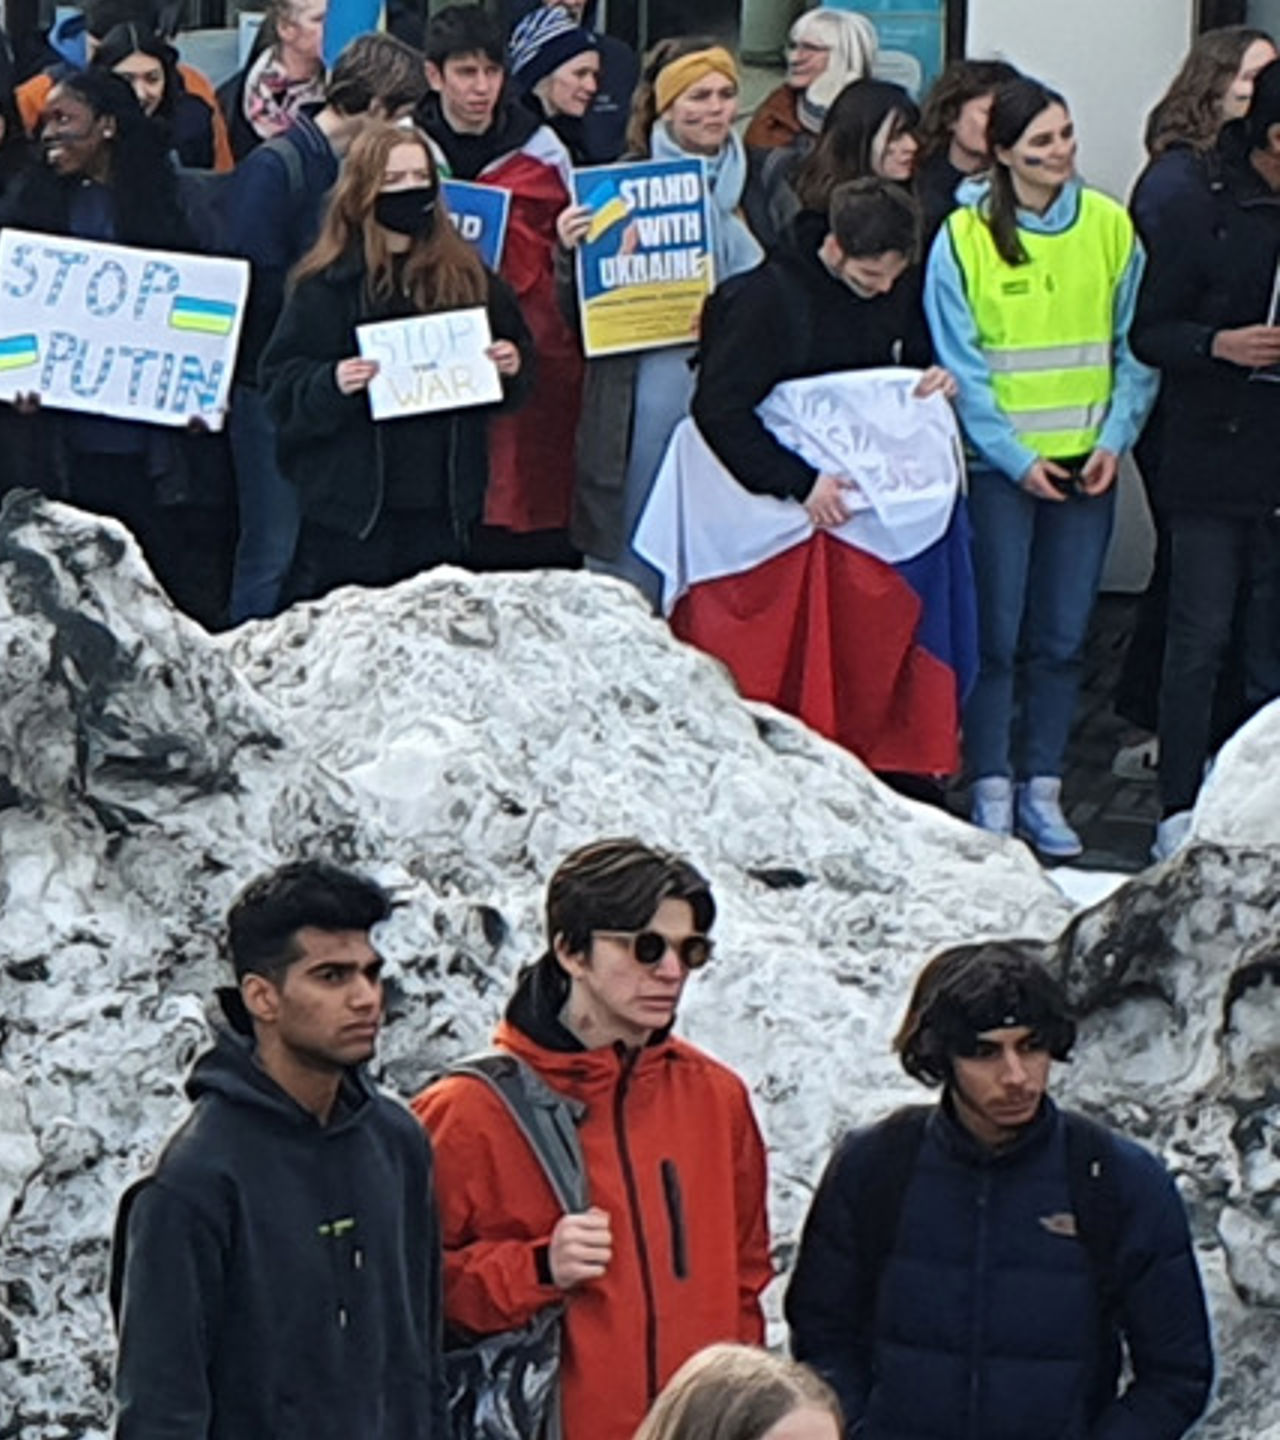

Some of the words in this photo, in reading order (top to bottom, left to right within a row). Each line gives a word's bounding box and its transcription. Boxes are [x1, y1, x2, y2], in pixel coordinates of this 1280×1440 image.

[620, 172, 700, 211] STAND
[636, 211, 701, 248] WITH
[3, 244, 180, 321] STOP
[599, 247, 704, 289] UKRAINE
[370, 315, 474, 364] STOP
[41, 331, 224, 414] PUTIN
[388, 365, 479, 408] WAR
